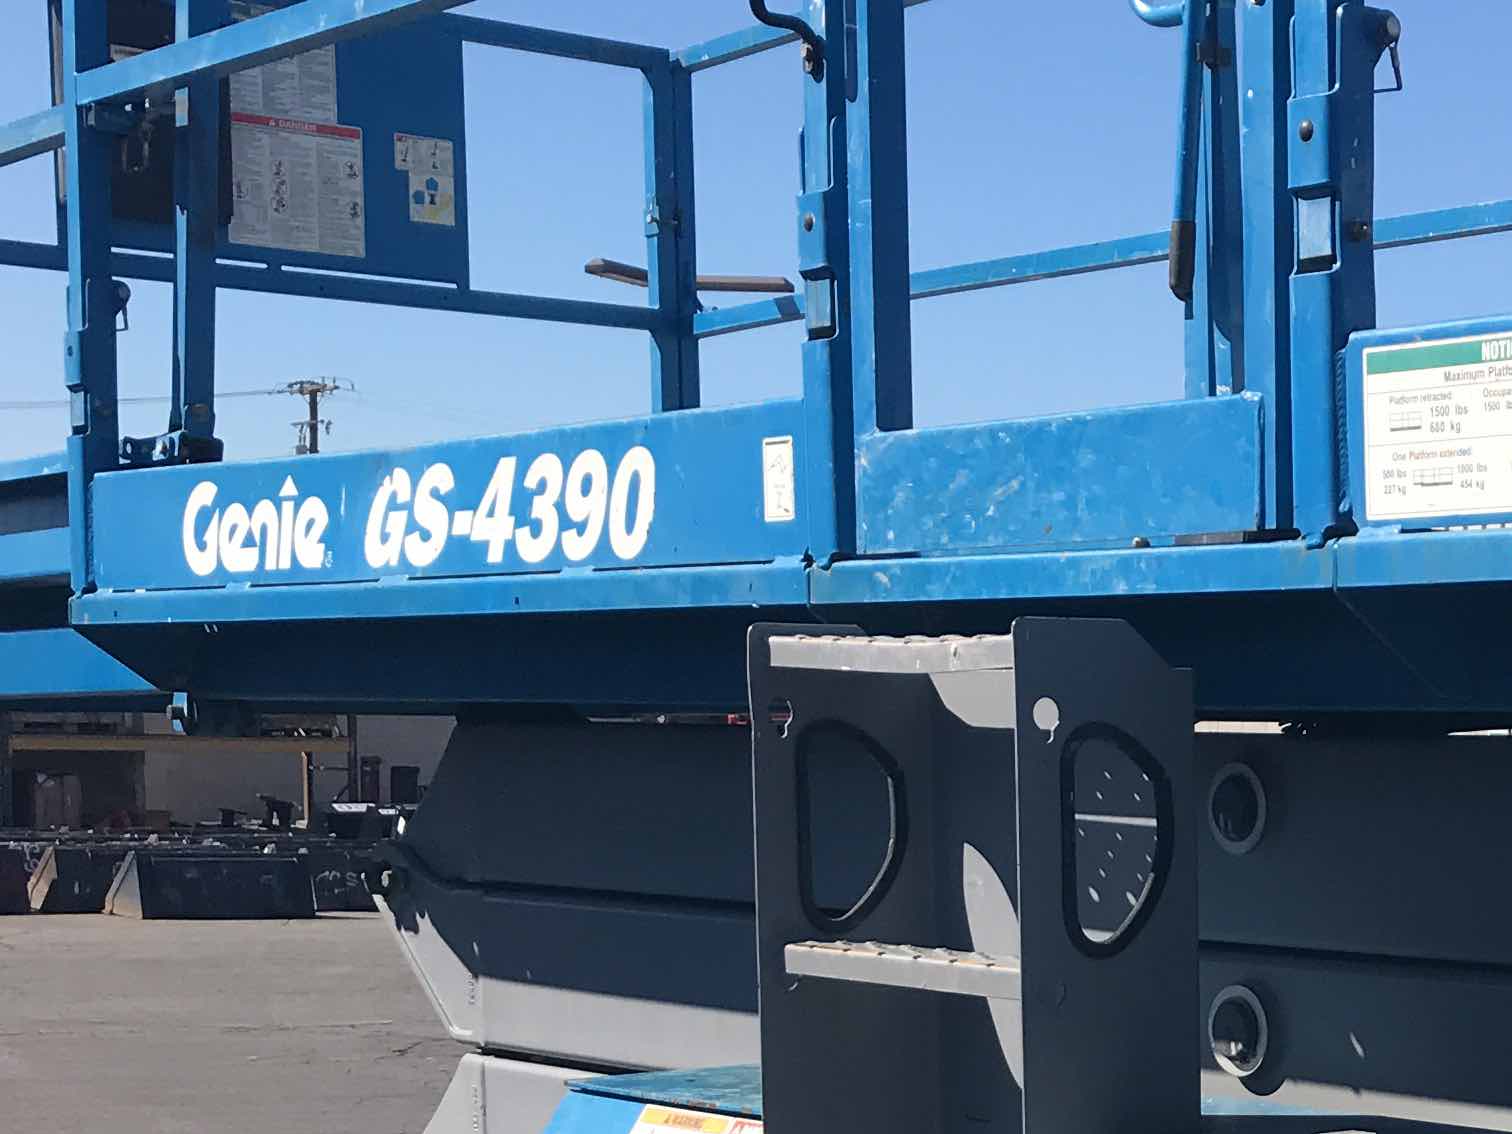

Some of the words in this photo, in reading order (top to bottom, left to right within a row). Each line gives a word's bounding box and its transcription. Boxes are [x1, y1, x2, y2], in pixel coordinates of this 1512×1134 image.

[1444, 368, 1485, 382] Maximum
[1430, 405, 1450, 418] 1500
[1455, 403, 1469, 416] lbs
[182, 475, 330, 576] Genie
[364, 446, 656, 569] GS-4390
